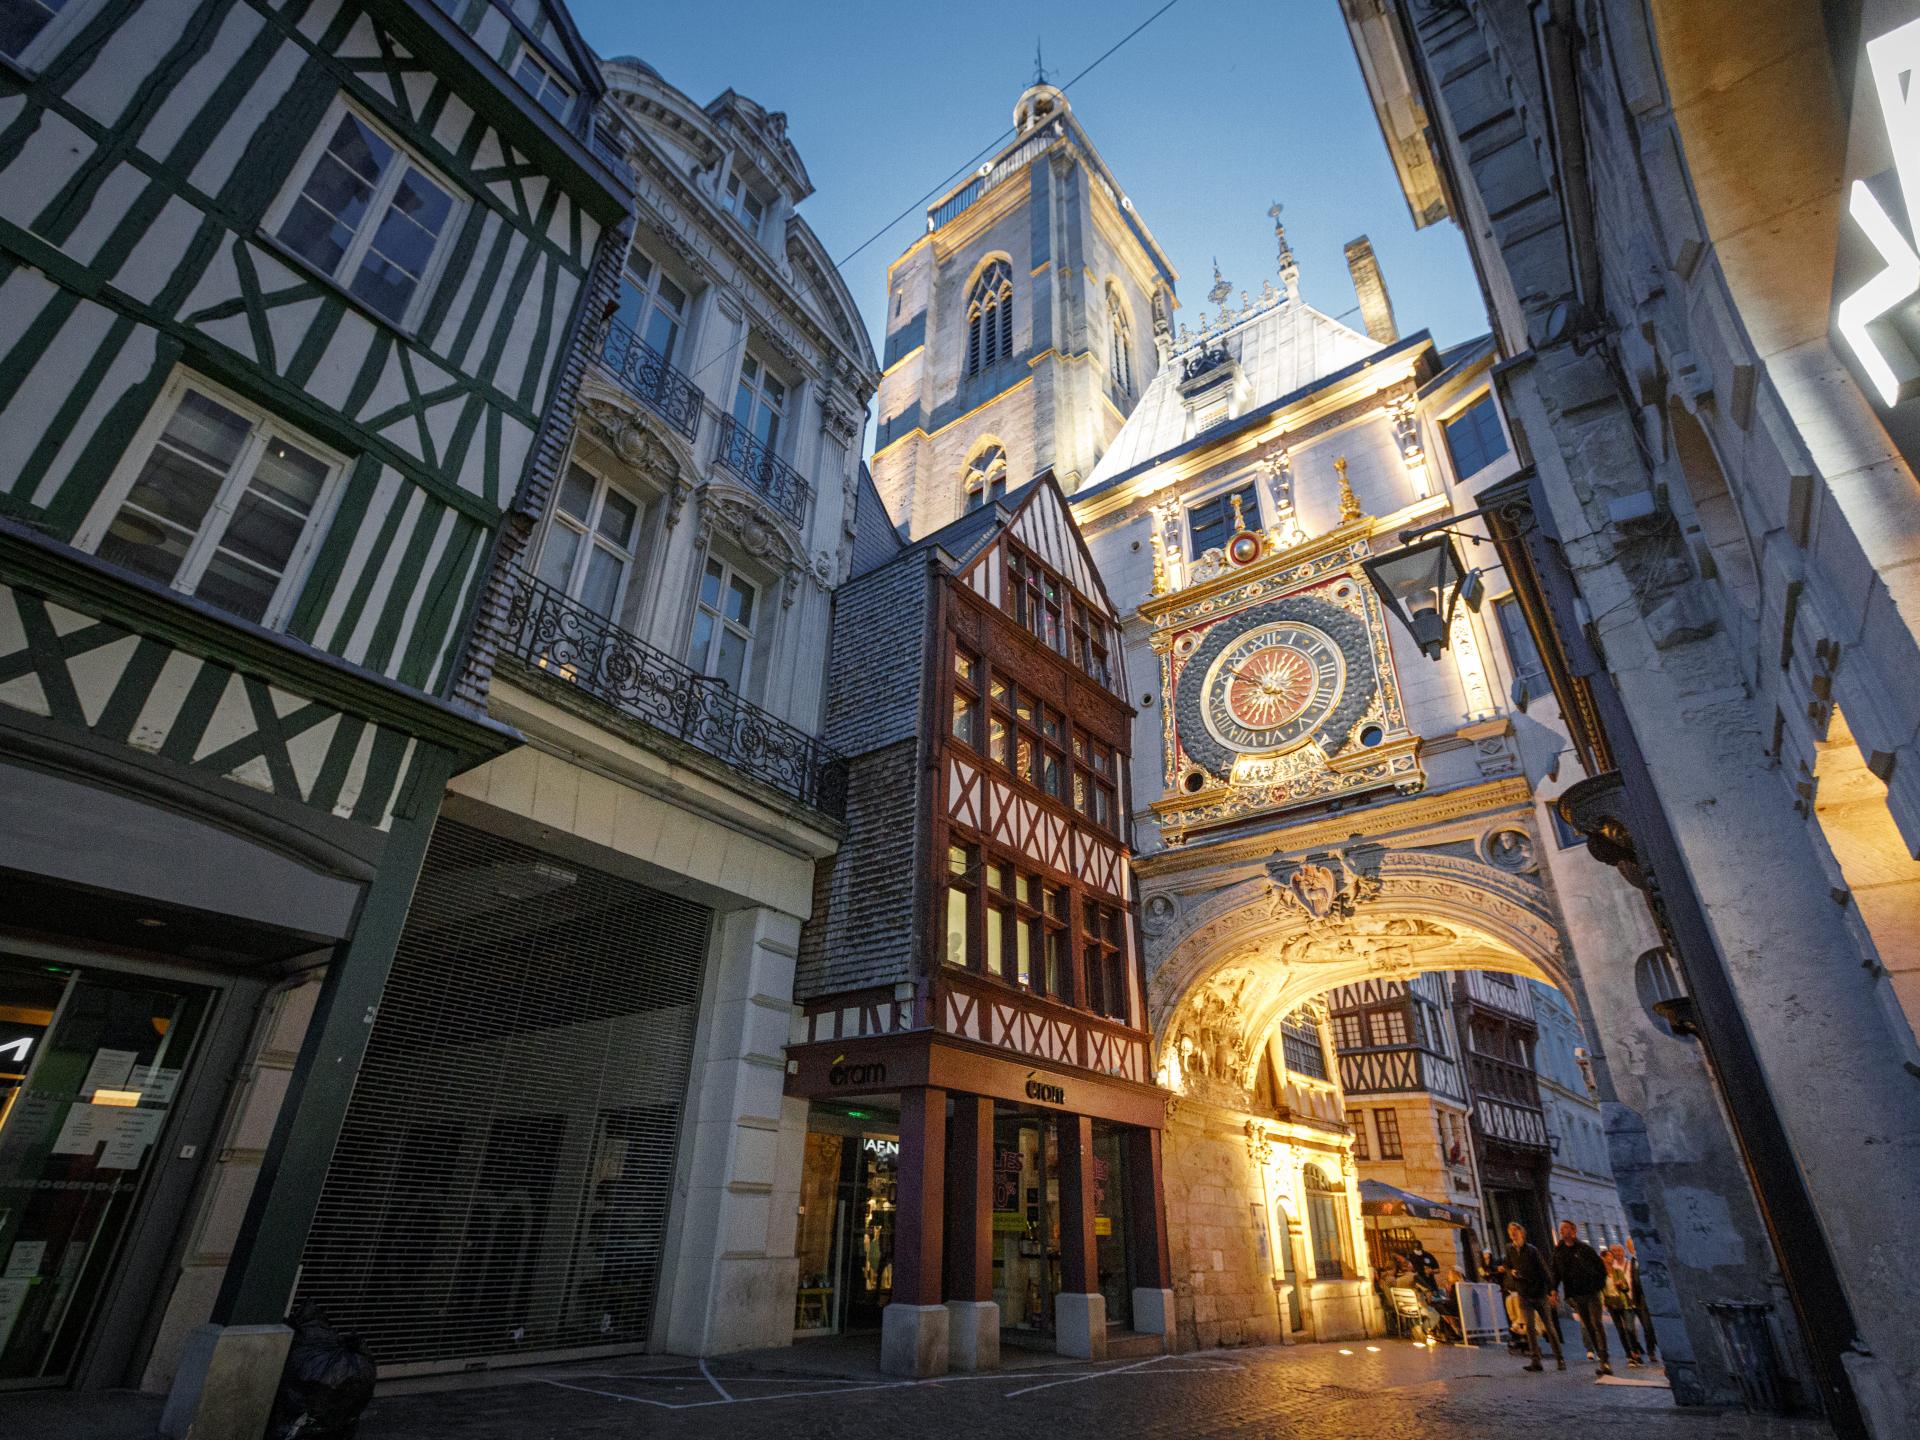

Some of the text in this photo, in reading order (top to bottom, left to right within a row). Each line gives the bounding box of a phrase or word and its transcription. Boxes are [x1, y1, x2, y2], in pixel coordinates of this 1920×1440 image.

[643, 183, 719, 268] HOTEL
[763, 303, 813, 360] NORD
[829, 1054, 887, 1086] éram
[1025, 1071, 1065, 1105] éram
